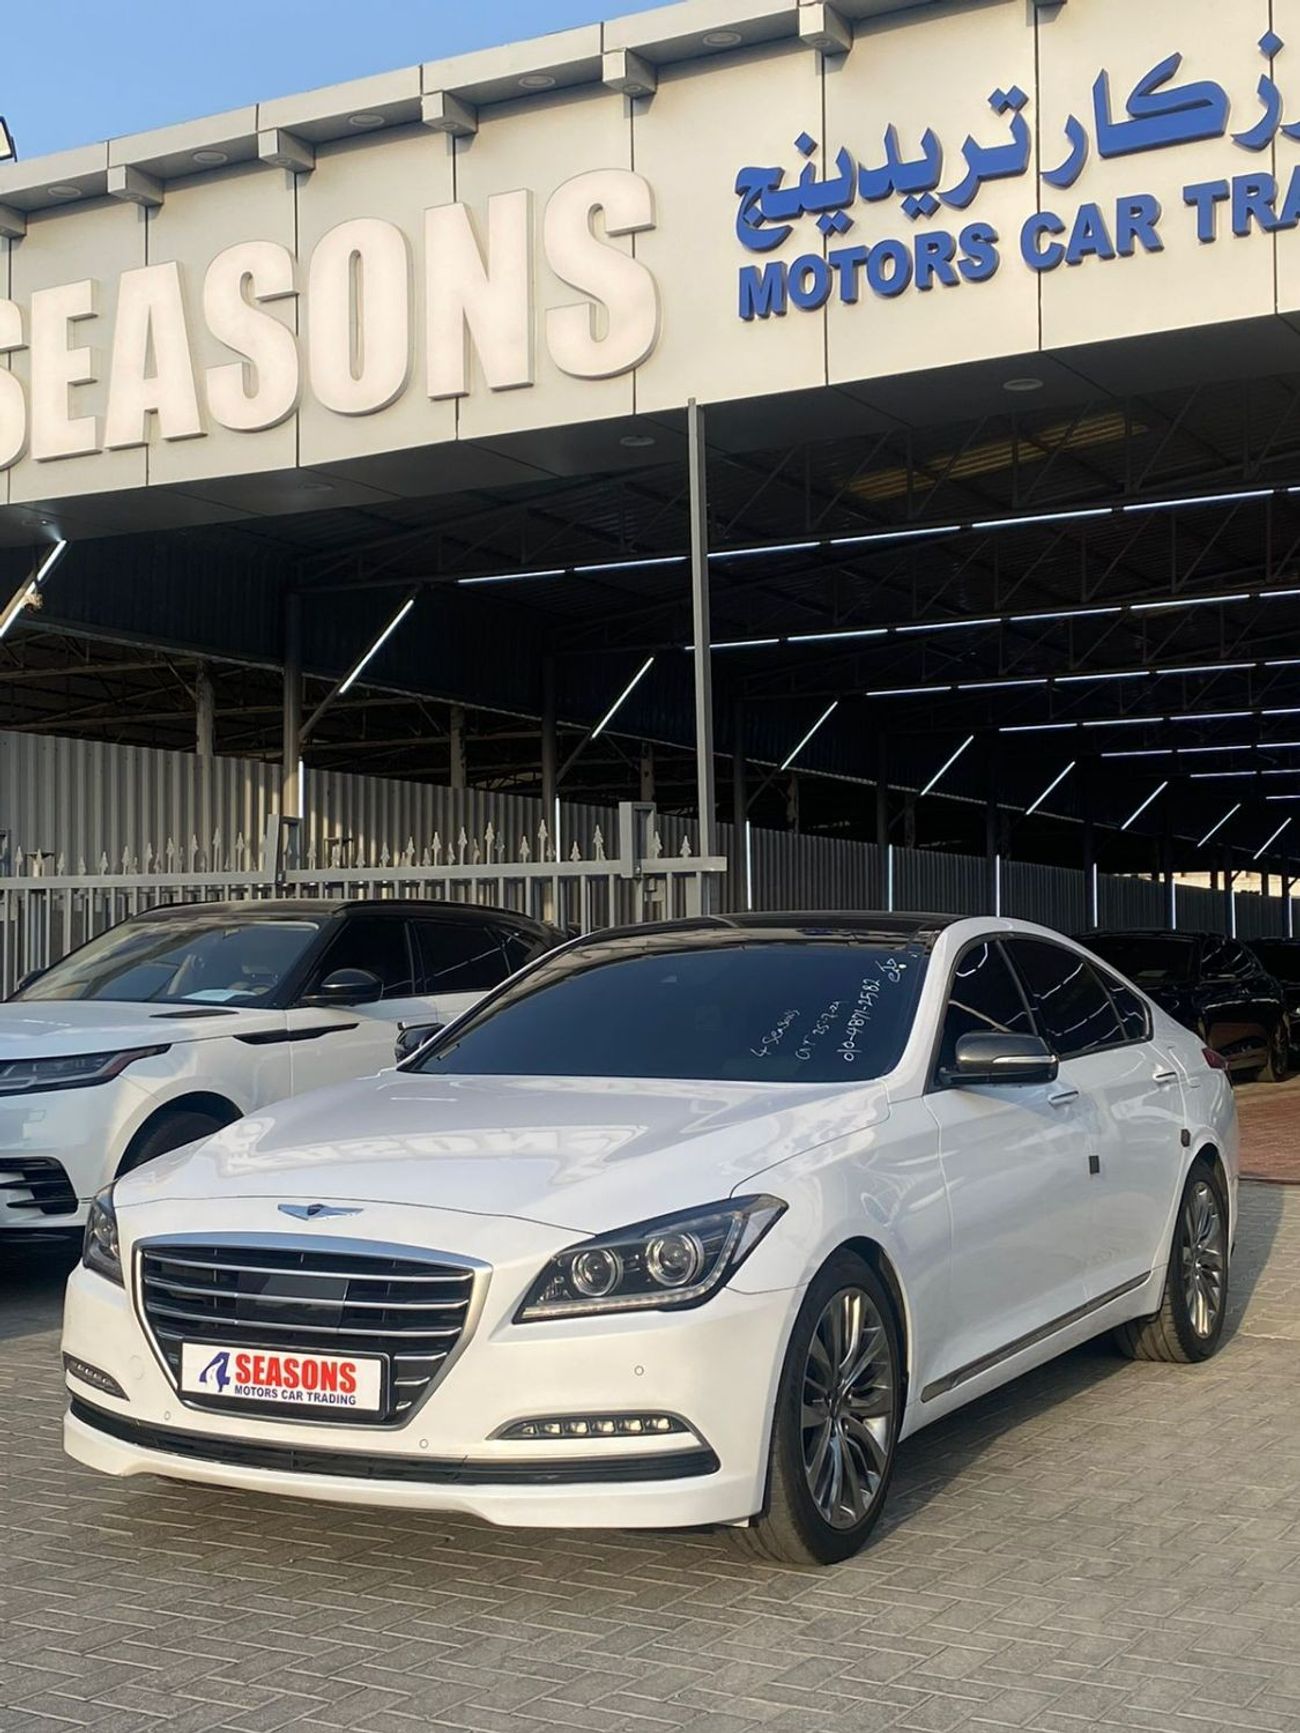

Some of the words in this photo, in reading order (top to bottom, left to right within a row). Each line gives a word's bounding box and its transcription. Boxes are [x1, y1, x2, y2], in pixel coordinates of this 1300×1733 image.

[735, 84, 1032, 252] تريدينج
[1038, 51, 1231, 189] كار
[738, 222, 1000, 321] MOTORS
[1020, 194, 1164, 272] CAR
[234, 1384, 279, 1399] MOTORS
[281, 1389, 304, 1402] CAR
[307, 1391, 357, 1406] TRADING
[235, 1353, 357, 1394] SEASONS
